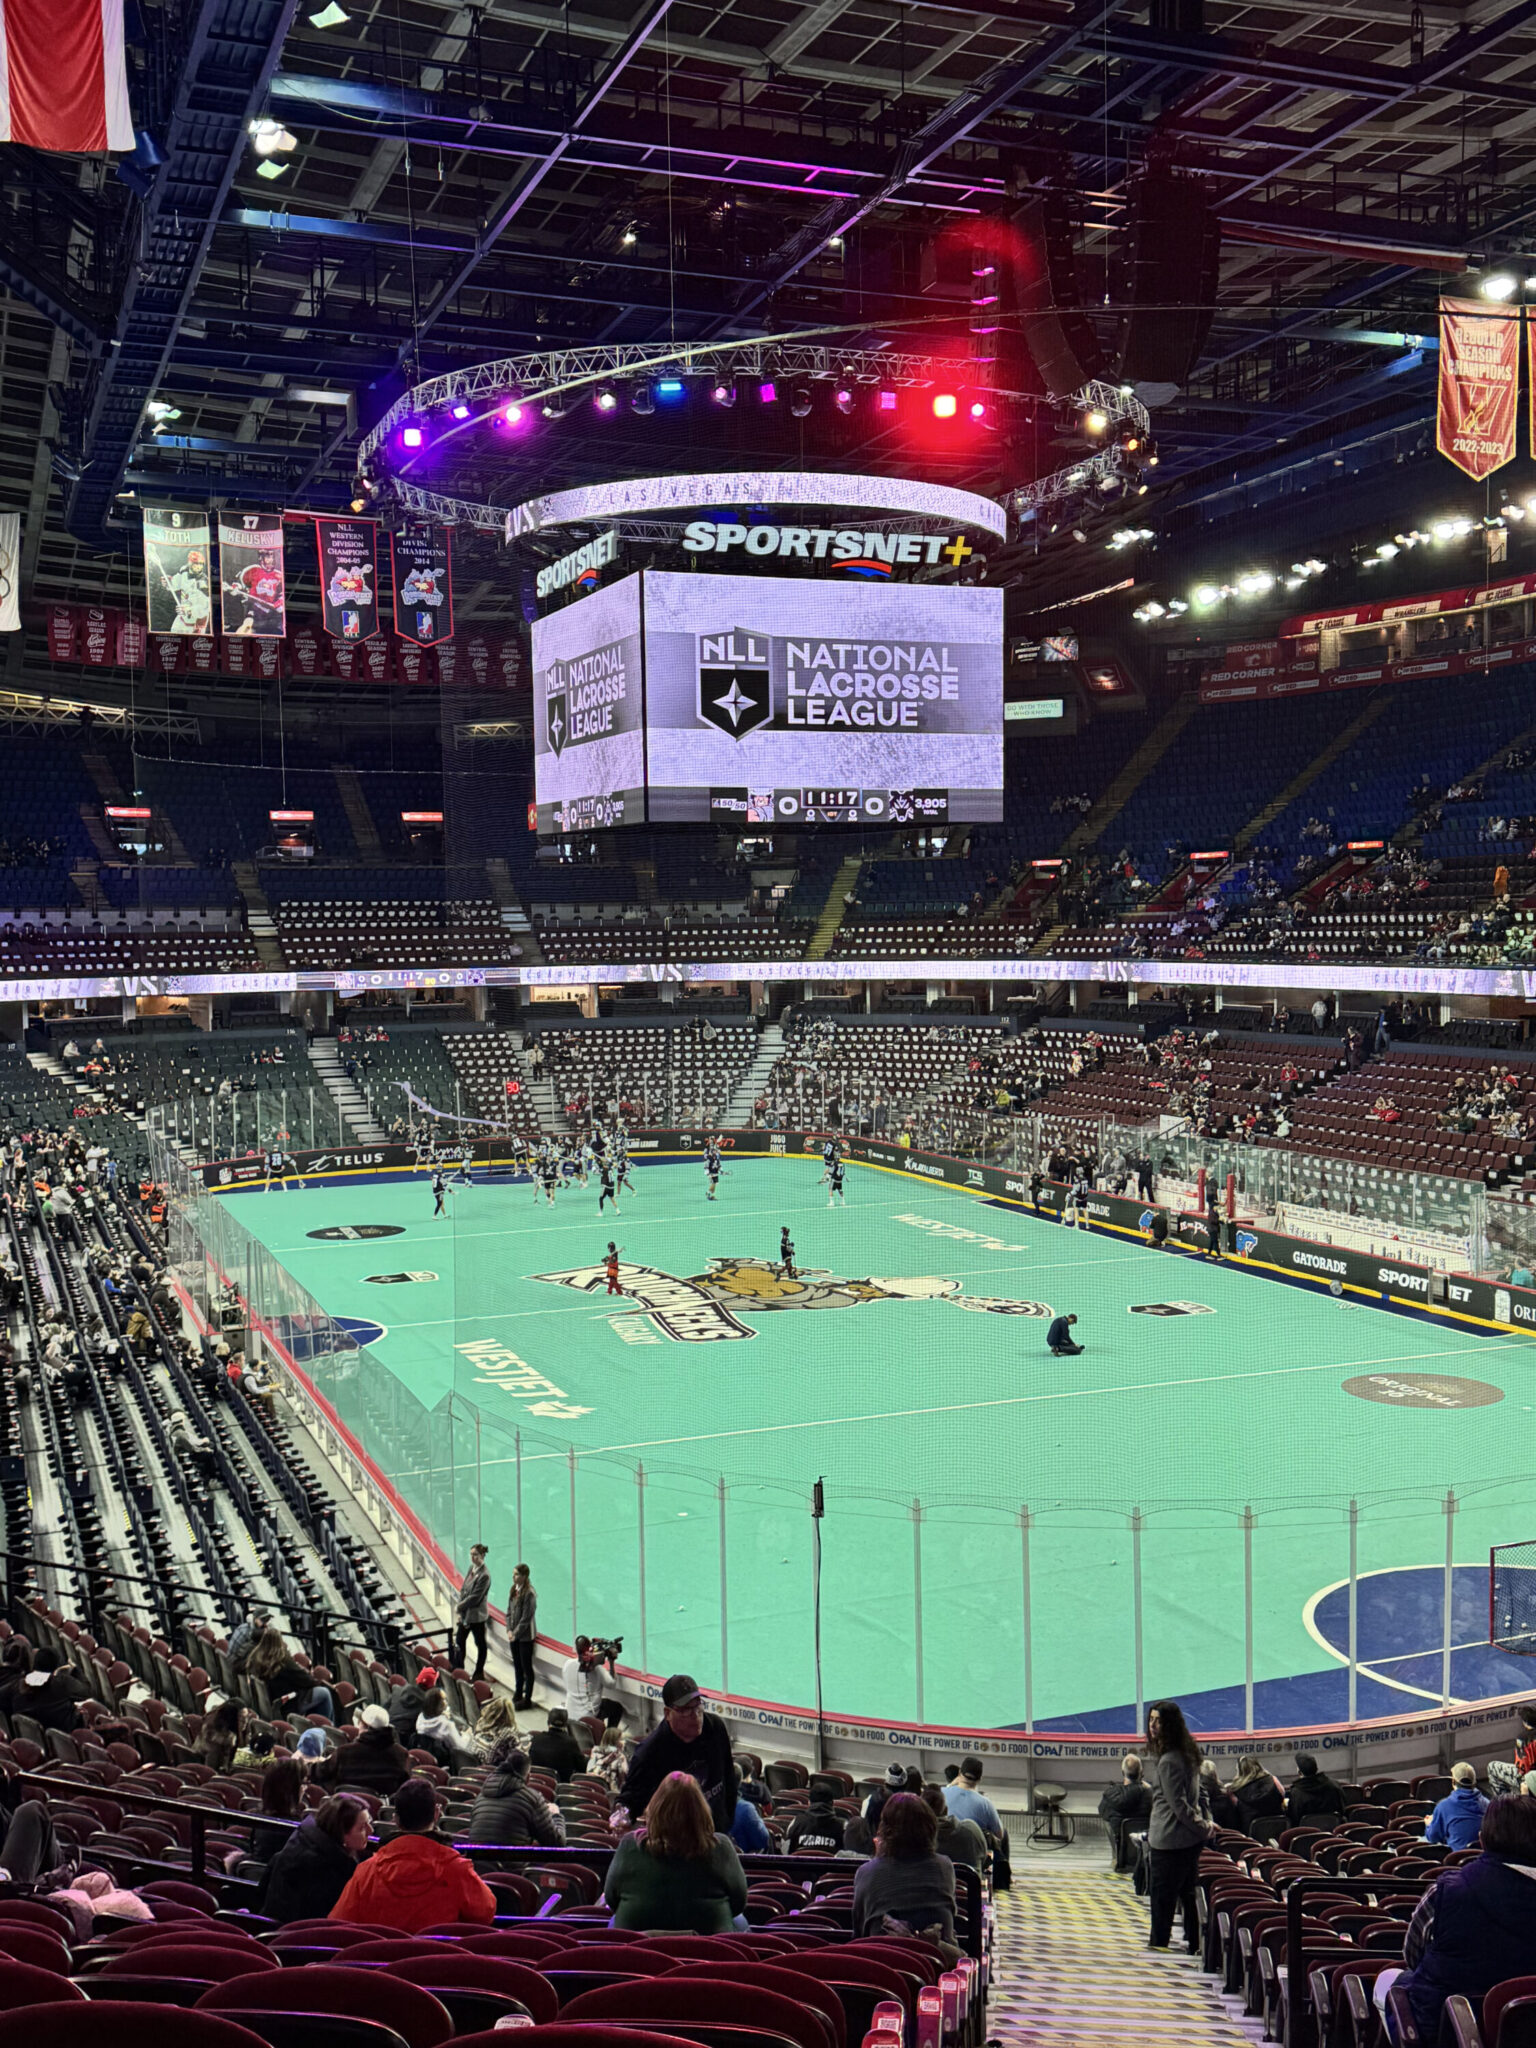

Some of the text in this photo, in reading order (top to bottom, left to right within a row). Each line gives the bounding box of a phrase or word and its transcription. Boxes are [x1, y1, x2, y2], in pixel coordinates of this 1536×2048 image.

[1455, 327, 1504, 348] REGULAR
[1459, 344, 1501, 363] SEASON
[1447, 359, 1512, 381] CHAMPIONS
[1452, 438, 1504, 455] 2022-2023
[609, 482, 750, 504] LAS VEGAS
[171, 513, 181, 527] 9
[242, 515, 259, 529] 17
[337, 523, 354, 532] NLL
[163, 530, 191, 543] TOTH
[227, 530, 275, 545] KELUSKY
[329, 532, 364, 540] WESTERN
[332, 540, 364, 548] DIVISION
[327, 547, 369, 556] CHAMPIONS
[397, 547, 446, 557] CHAMPIONS
[414, 557, 430, 565] 2014
[536, 530, 617, 598] SPORTSNET
[703, 635, 766, 663] NLL
[1243, 641, 1278, 652] CORNER
[787, 642, 959, 673] NATIONAL
[569, 645, 625, 688] NATIONAL
[1210, 667, 1276, 683] RED CORNER
[547, 666, 565, 694] NLL
[787, 671, 959, 701] LACROSSE
[570, 672, 626, 715] LACROSSE
[787, 699, 919, 727] LEAGUE
[1037, 702, 1059, 710] THOSE
[571, 705, 613, 741] LEAGUE
[578, 799, 595, 813] 11:17
[778, 797, 799, 816] 0
[807, 791, 859, 806] 11:17
[865, 797, 884, 816] 0
[915, 798, 947, 809] 3,905
[570, 807, 577, 824] 0
[596, 803, 603, 821] 0
[370, 974, 383, 986] 0
[388, 972, 424, 982] 11:17
[438, 972, 450, 984] 0
[650, 962, 683, 982] VS
[1106, 961, 1128, 982] VS
[122, 975, 159, 997] VS
[506, 1081, 519, 1094] 30
[770, 1134, 786, 1144] JUGO
[769, 1144, 786, 1154] JUICE
[334, 1153, 384, 1167] TELUS
[967, 1168, 983, 1180] TCS
[889, 1213, 1004, 1243] WESTJET
[1292, 1250, 1347, 1275] GATORADE
[1378, 1268, 1473, 1303] SPORTNET
[607, 1316, 664, 1346] CALGARY
[453, 1338, 570, 1398] WESTJET
[1369, 1376, 1463, 1407] ORIGINAL
[739, 1708, 756, 1720] FOOD
[758, 1711, 783, 1727] OPA!
[784, 1717, 797, 1729] THE
[823, 1724, 834, 1734] OF
[866, 1730, 885, 1742] FOOD
[888, 1731, 917, 1746] OPA!
[918, 1736, 932, 1747] THE
[933, 1738, 961, 1750] POWER
[962, 1740, 973, 1750] OF
[1008, 1743, 1029, 1754] FOOD
[1033, 1743, 1064, 1758] OPA!
[1064, 1745, 1079, 1756] THE
[1081, 1746, 1109, 1757] POWER
[1110, 1746, 1122, 1757] OF
[1211, 1745, 1226, 1755] THE
[1228, 1744, 1255, 1755] POWER
[1256, 1743, 1267, 1753] OF
[1301, 1739, 1320, 1750] FOOD
[1322, 1734, 1350, 1750] OPA!
[1351, 1734, 1364, 1745] THE
[1365, 1731, 1390, 1743] POWER
[1390, 1730, 1399, 1740] OF
[1430, 1722, 1447, 1734] FOOD
[1449, 1714, 1474, 1731] OPA!
[1473, 1714, 1485, 1725] THE
[1486, 1709, 1508, 1722] POWER
